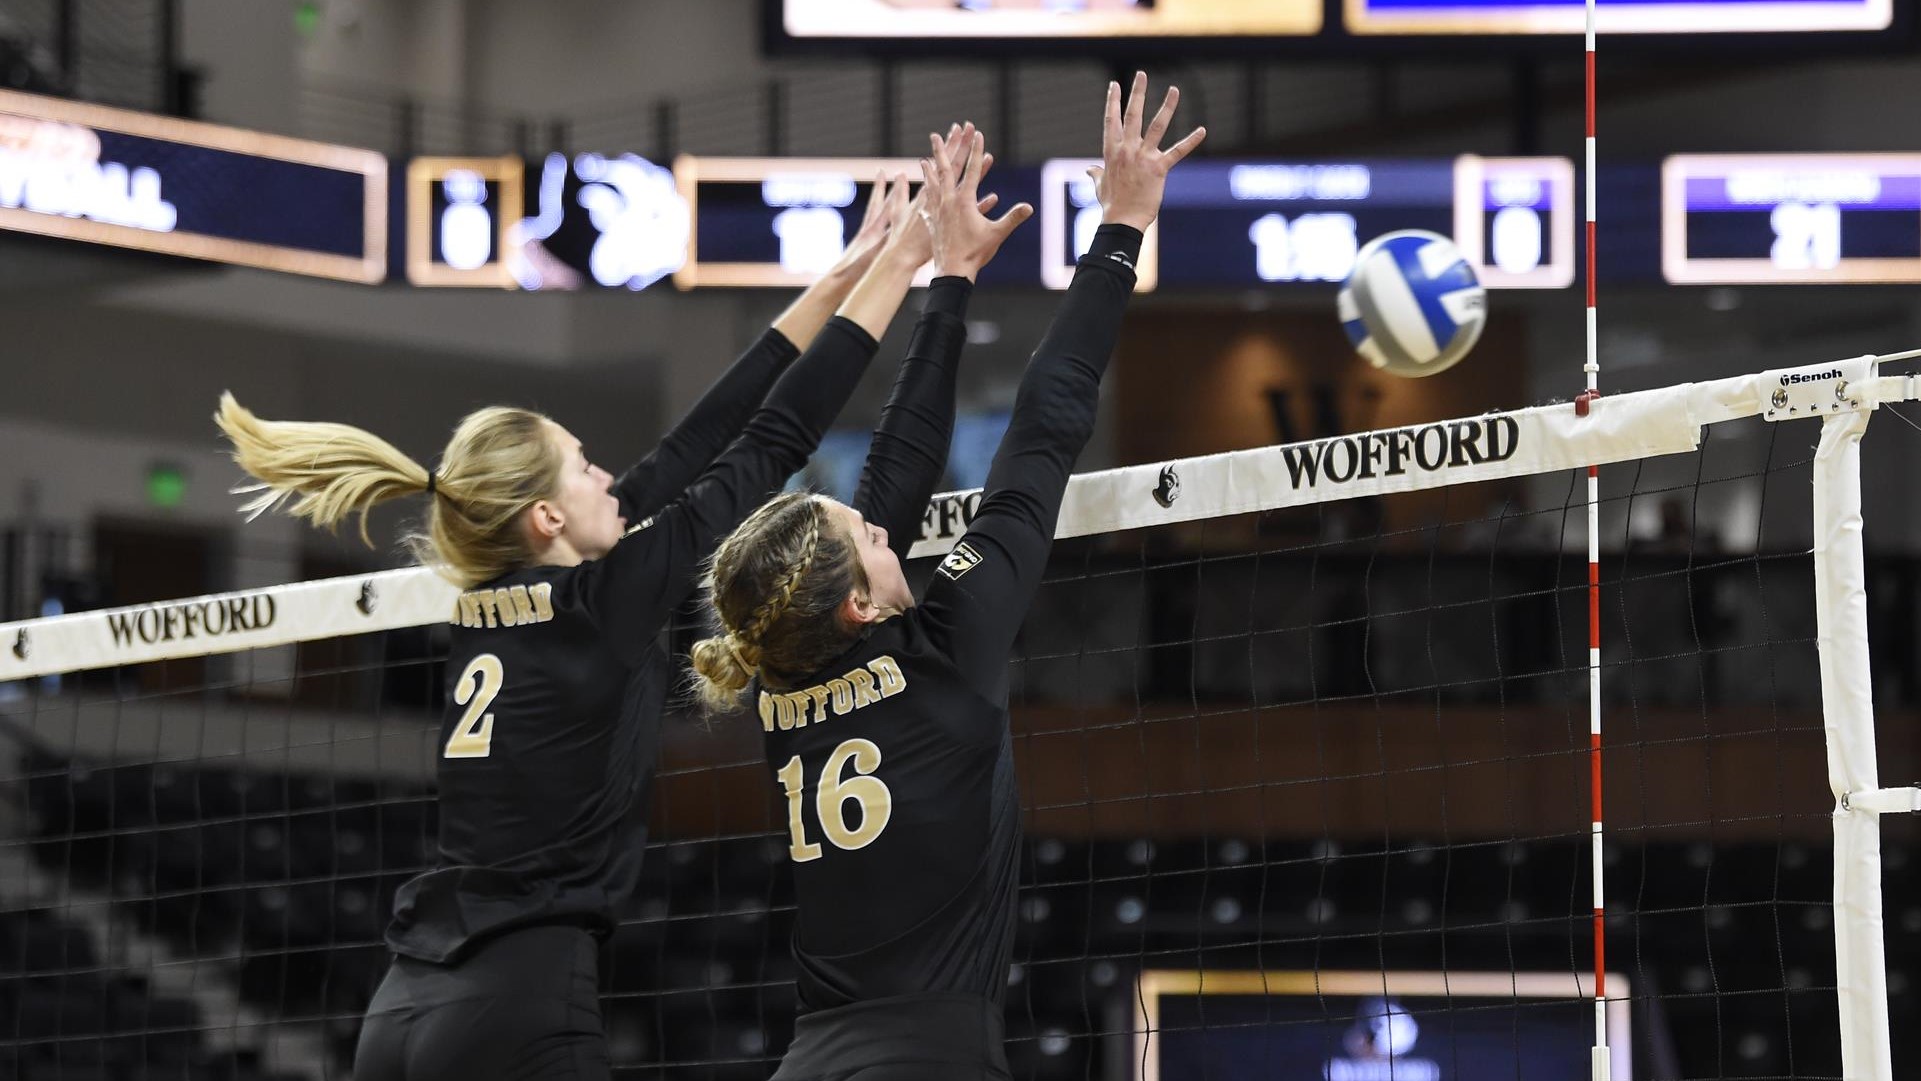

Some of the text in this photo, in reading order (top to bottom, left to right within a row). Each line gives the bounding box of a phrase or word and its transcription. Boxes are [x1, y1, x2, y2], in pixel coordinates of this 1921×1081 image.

[1789, 369, 1843, 385] Senoh
[1280, 415, 1519, 490] WOFFORD
[107, 593, 276, 648] WOFFORD
[444, 653, 504, 758] 2
[777, 738, 892, 863] 16
